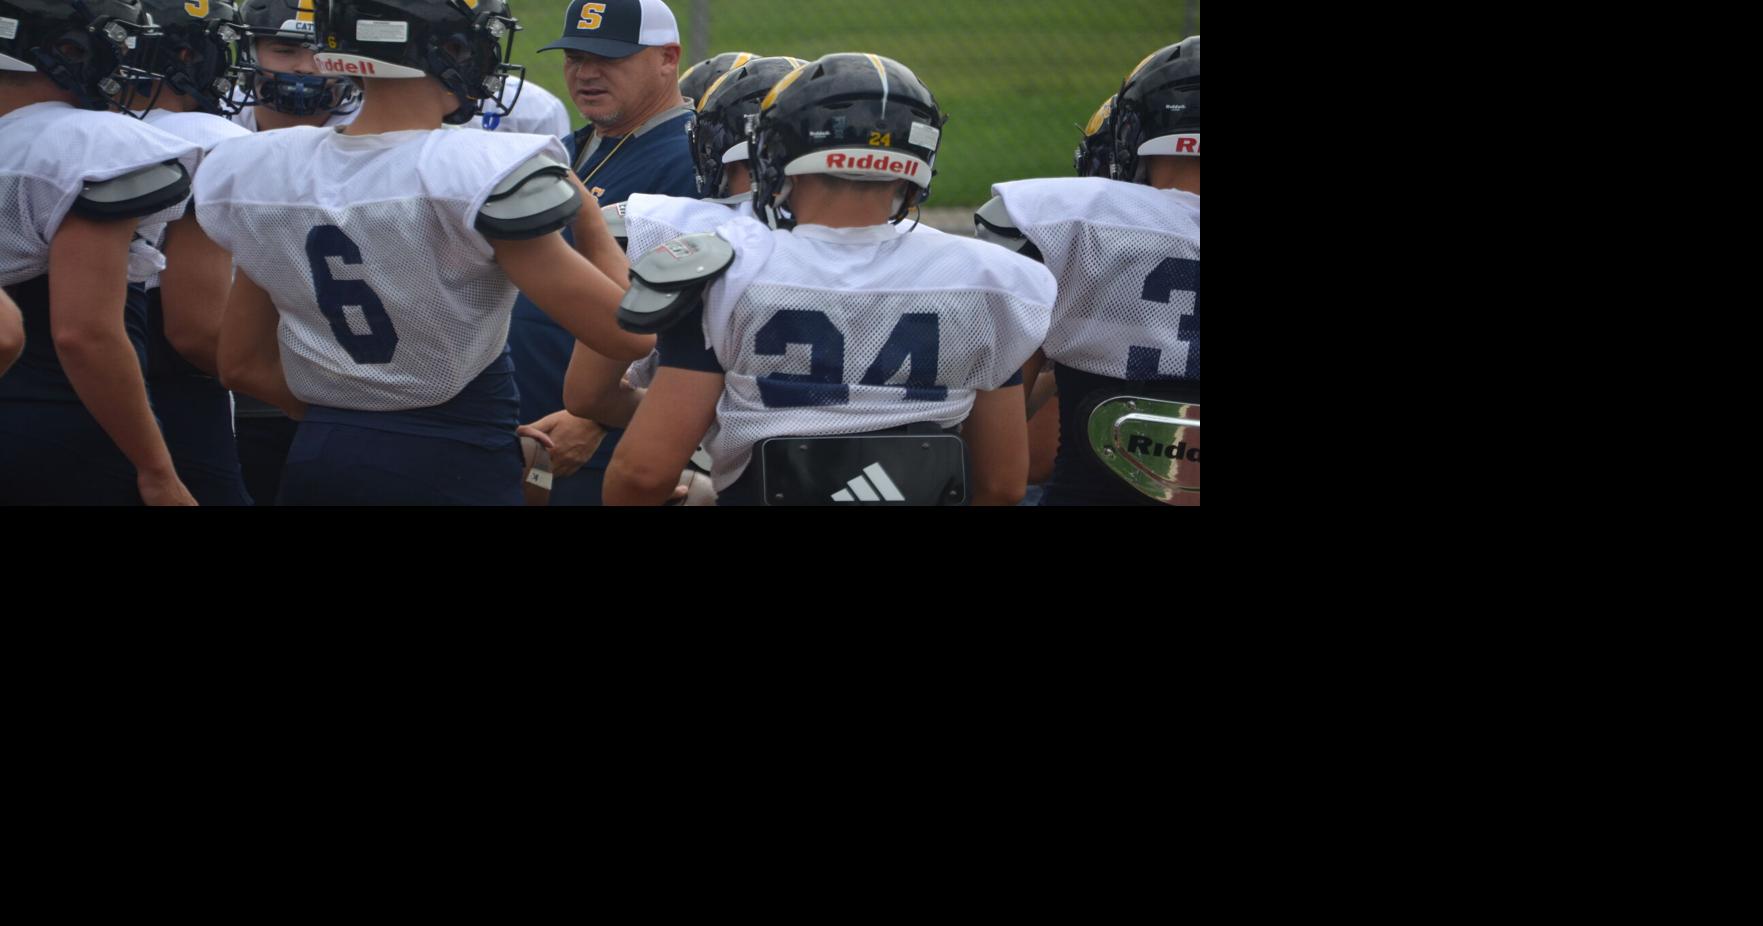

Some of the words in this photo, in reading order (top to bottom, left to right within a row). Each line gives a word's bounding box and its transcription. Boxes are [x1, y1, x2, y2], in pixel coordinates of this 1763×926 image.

[577, 2, 606, 30] S
[327, 35, 337, 49] 6
[315, 57, 376, 75] ddell
[868, 130, 893, 147] 24
[825, 152, 919, 177] Riddell
[305, 223, 399, 365] 6
[754, 308, 948, 408] 24
